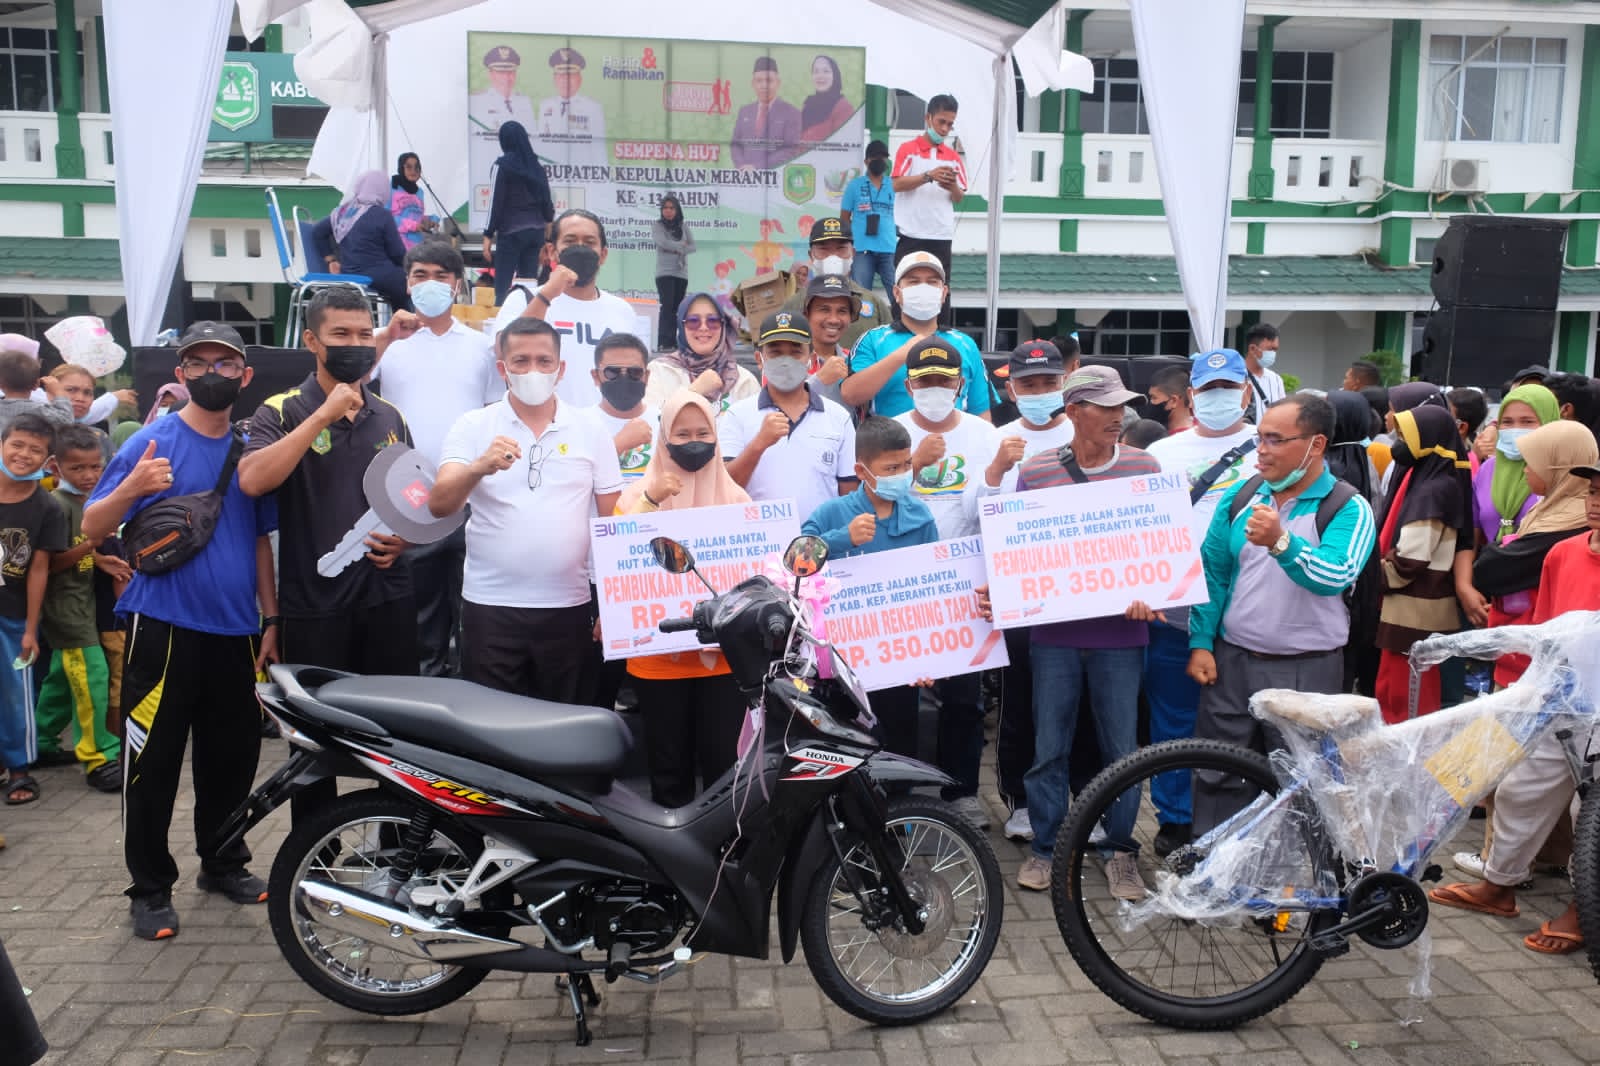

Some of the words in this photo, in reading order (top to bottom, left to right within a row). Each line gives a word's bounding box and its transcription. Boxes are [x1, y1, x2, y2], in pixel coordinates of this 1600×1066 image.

[603, 66, 665, 81] Ramaikan
[615, 142, 686, 162] SEMPENA
[687, 144, 720, 163] HUT
[544, 164, 610, 181] BUPATEN
[615, 167, 706, 183] KEPULAUAN
[711, 170, 777, 186] MERANTI
[616, 189, 637, 204] KE
[713, 220, 738, 229] Setia
[1148, 475, 1181, 492] BNI
[761, 503, 793, 519] BNI
[1017, 514, 1077, 531] DOORPRIZE
[1080, 510, 1113, 523] JALAN
[1117, 504, 1155, 518] SANTAI
[693, 536, 727, 549] JALAN
[729, 532, 767, 545] SANTAI
[1006, 532, 1027, 545] HUT
[1030, 530, 1056, 543] KAB.
[1058, 527, 1081, 539] KEP.
[1084, 522, 1132, 535] MERANTI
[1135, 514, 1171, 528] KE-XIII
[617, 558, 640, 571] HUT
[696, 547, 743, 561] MERANTI
[746, 543, 781, 557] KE-XIII
[950, 538, 981, 557] BNI
[993, 544, 1072, 577] PEMBUKAAN
[1074, 533, 1141, 567] REKENING
[1141, 527, 1192, 556] TAPLUS
[603, 571, 684, 605] PEMBUKAAN
[886, 577, 919, 591] JALAN
[921, 569, 958, 584] SANTAI
[1021, 575, 1061, 601] RP.
[1069, 560, 1172, 595] 350.000
[839, 600, 864, 614] KAB.
[866, 595, 889, 608] KEP.
[890, 586, 936, 602] MERANTI
[938, 580, 972, 596] KE-XIII
[631, 603, 667, 630] RP
[881, 601, 945, 635] REKENING
[877, 626, 975, 664] 350.000
[805, 751, 845, 764] HONDA
